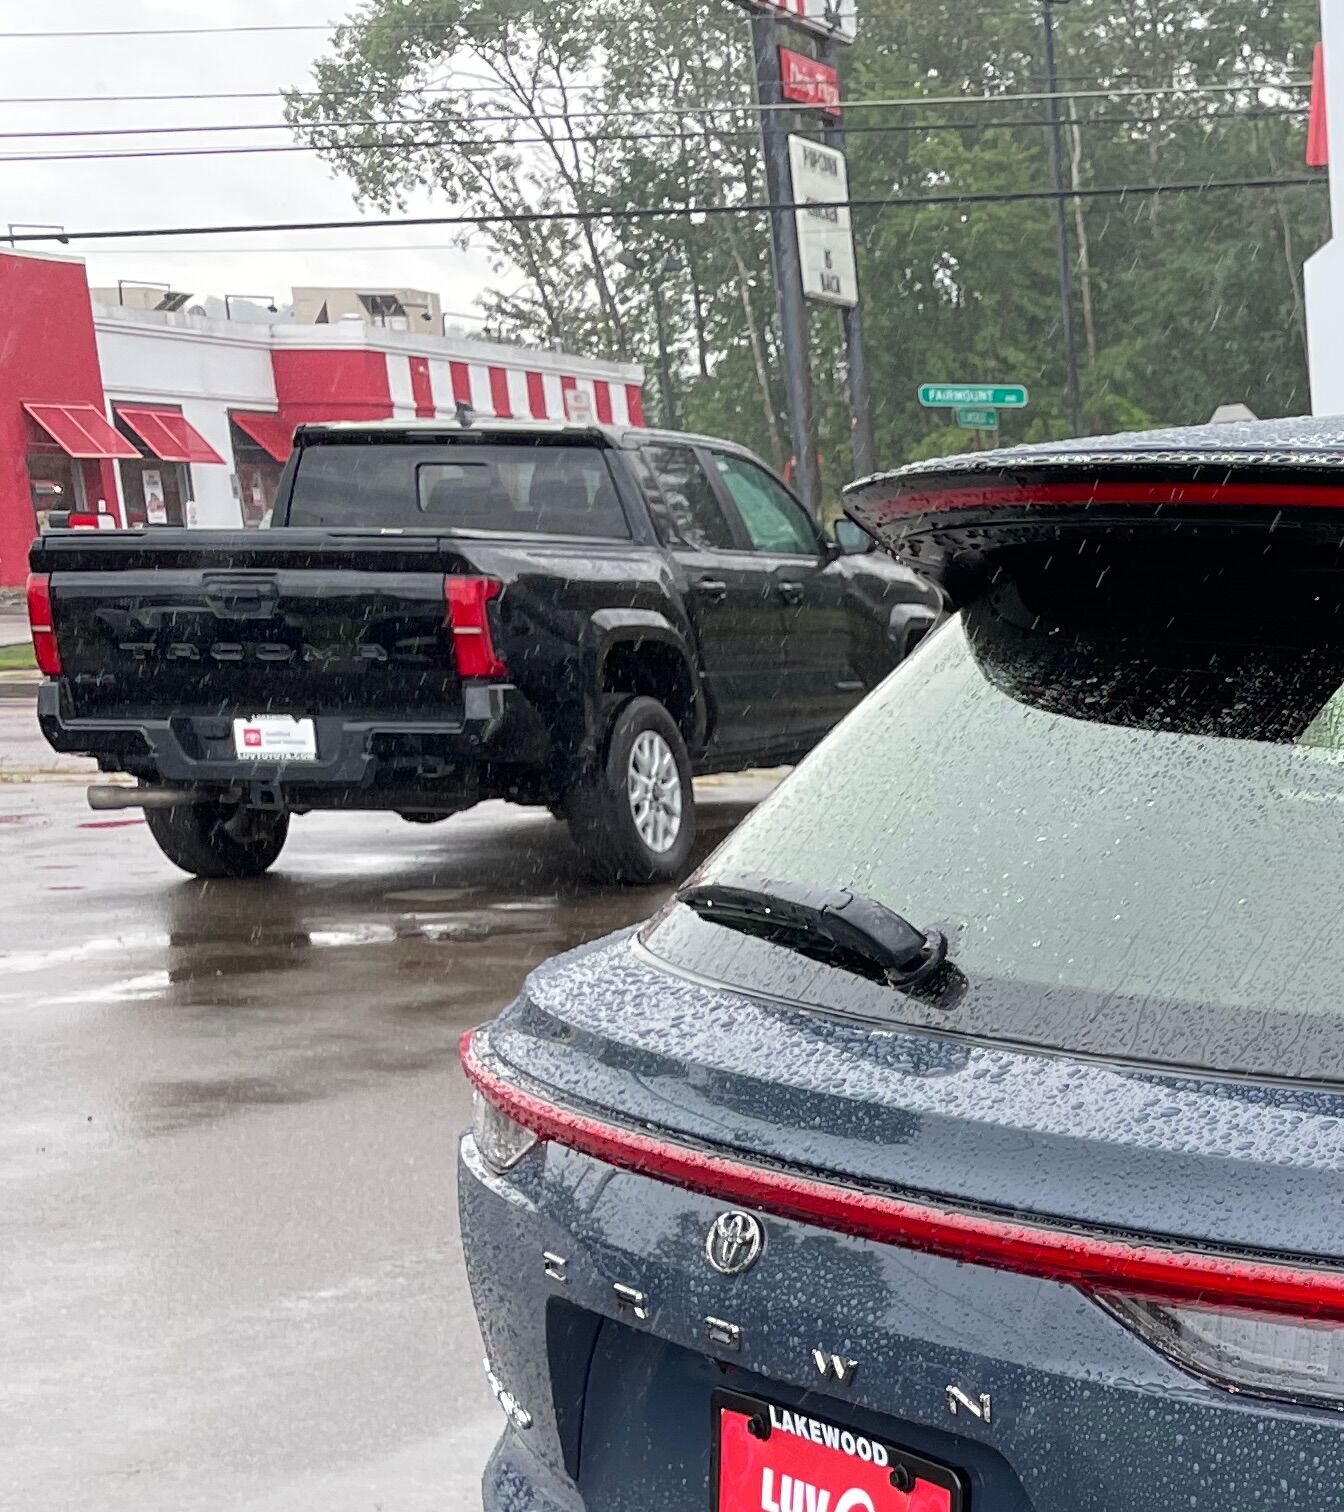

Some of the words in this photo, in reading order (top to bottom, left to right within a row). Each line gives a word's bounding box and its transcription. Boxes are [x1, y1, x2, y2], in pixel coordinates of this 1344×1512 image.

[928, 389, 994, 402] FAIRMOUNT
[118, 642, 388, 661] TACOMA
[543, 1250, 992, 1423] CROWN
[768, 1404, 889, 1467] LAKEWOOD
